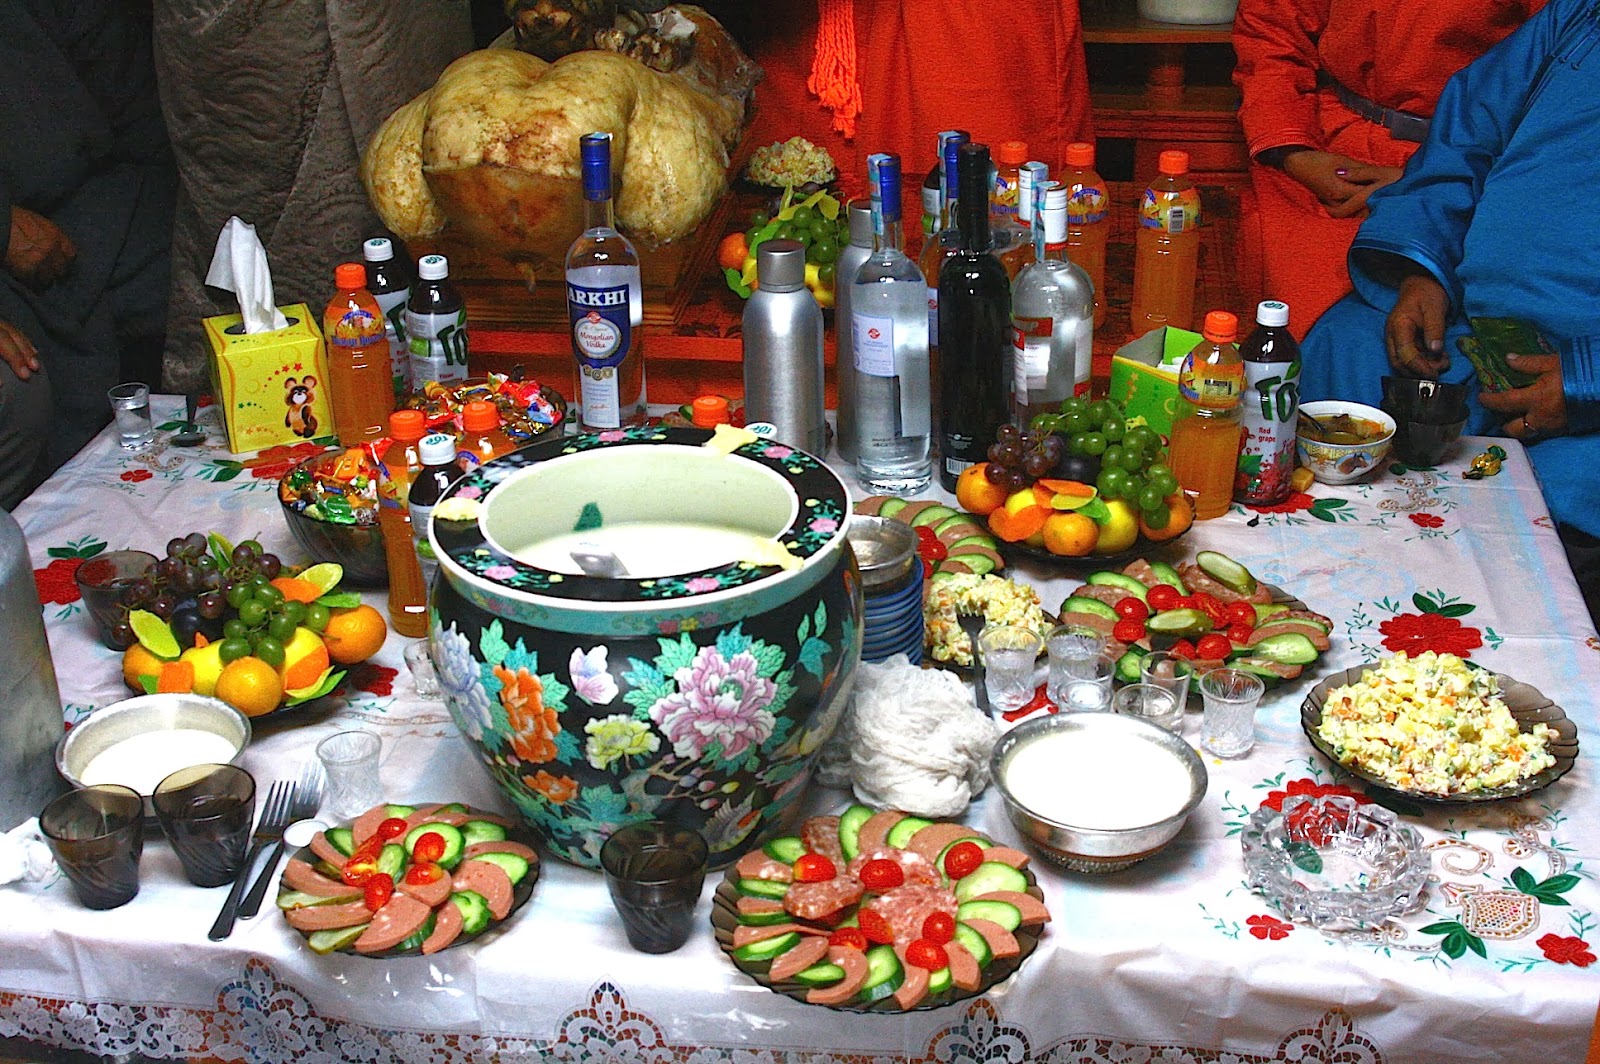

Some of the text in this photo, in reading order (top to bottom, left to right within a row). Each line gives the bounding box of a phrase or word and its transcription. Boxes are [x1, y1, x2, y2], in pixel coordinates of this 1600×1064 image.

[569, 286, 626, 306] ARKHI
[436, 325, 467, 366] TO
[580, 331, 614, 341] Mongolian
[586, 341, 606, 349] Vodka
[1255, 375, 1298, 423] TO
